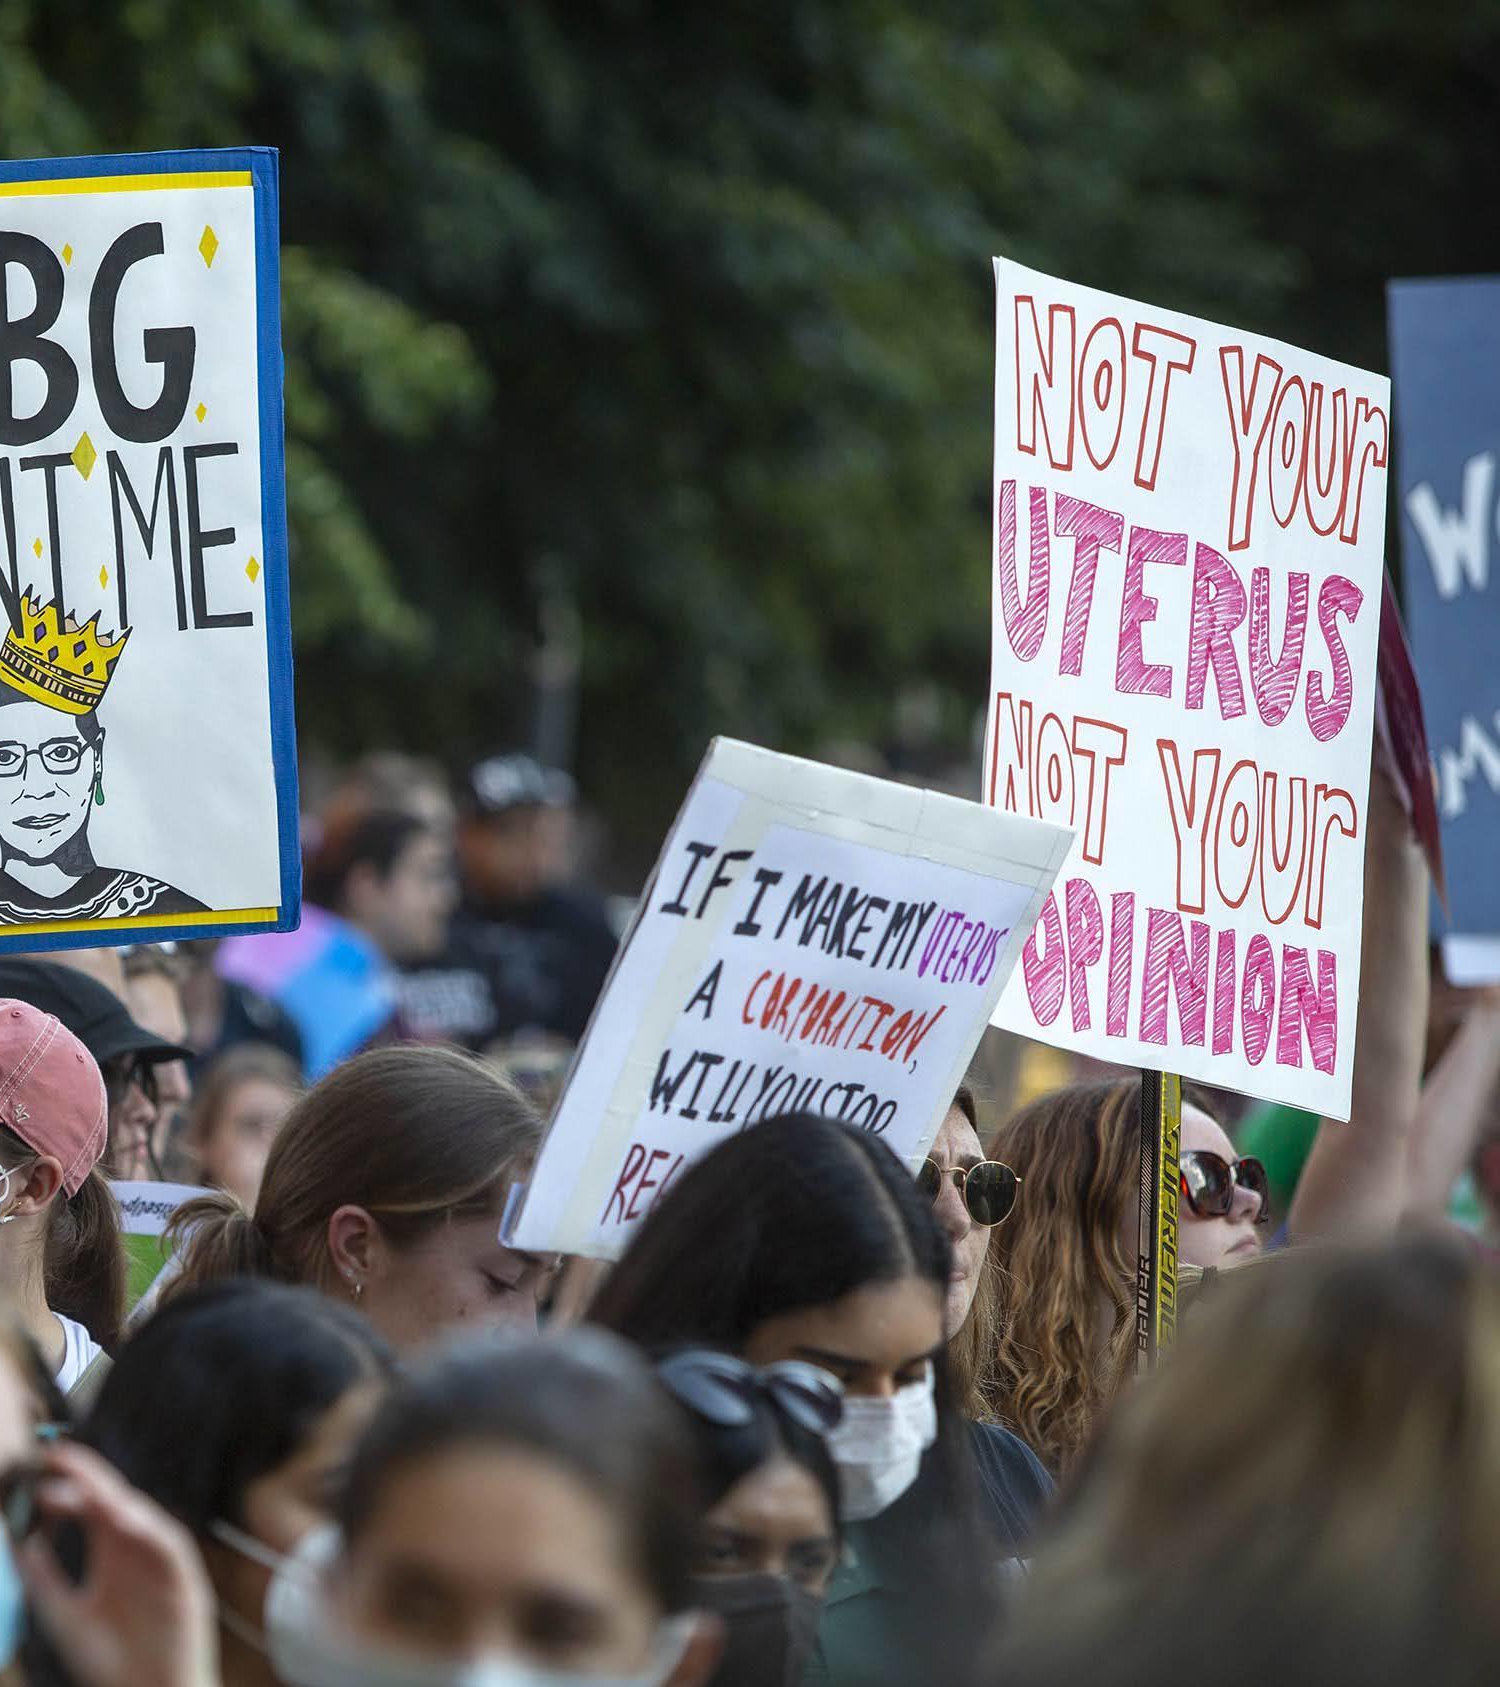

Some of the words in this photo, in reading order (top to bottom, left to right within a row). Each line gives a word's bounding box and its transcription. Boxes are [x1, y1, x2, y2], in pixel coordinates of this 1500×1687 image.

[1014, 295, 1196, 491] NOT
[107, 442, 254, 632] ME
[999, 480, 1364, 742] UTERUS
[1405, 450, 1500, 600] W
[990, 692, 1128, 866] NOT
[660, 842, 754, 919] IF
[733, 868, 783, 936] I
[774, 874, 890, 960] MAKE
[870, 901, 936, 970] MY
[917, 908, 1010, 986] UTERUS
[684, 959, 723, 1020] A
[1022, 878, 1336, 1076] OPINION
[649, 1049, 756, 1123] WILL
